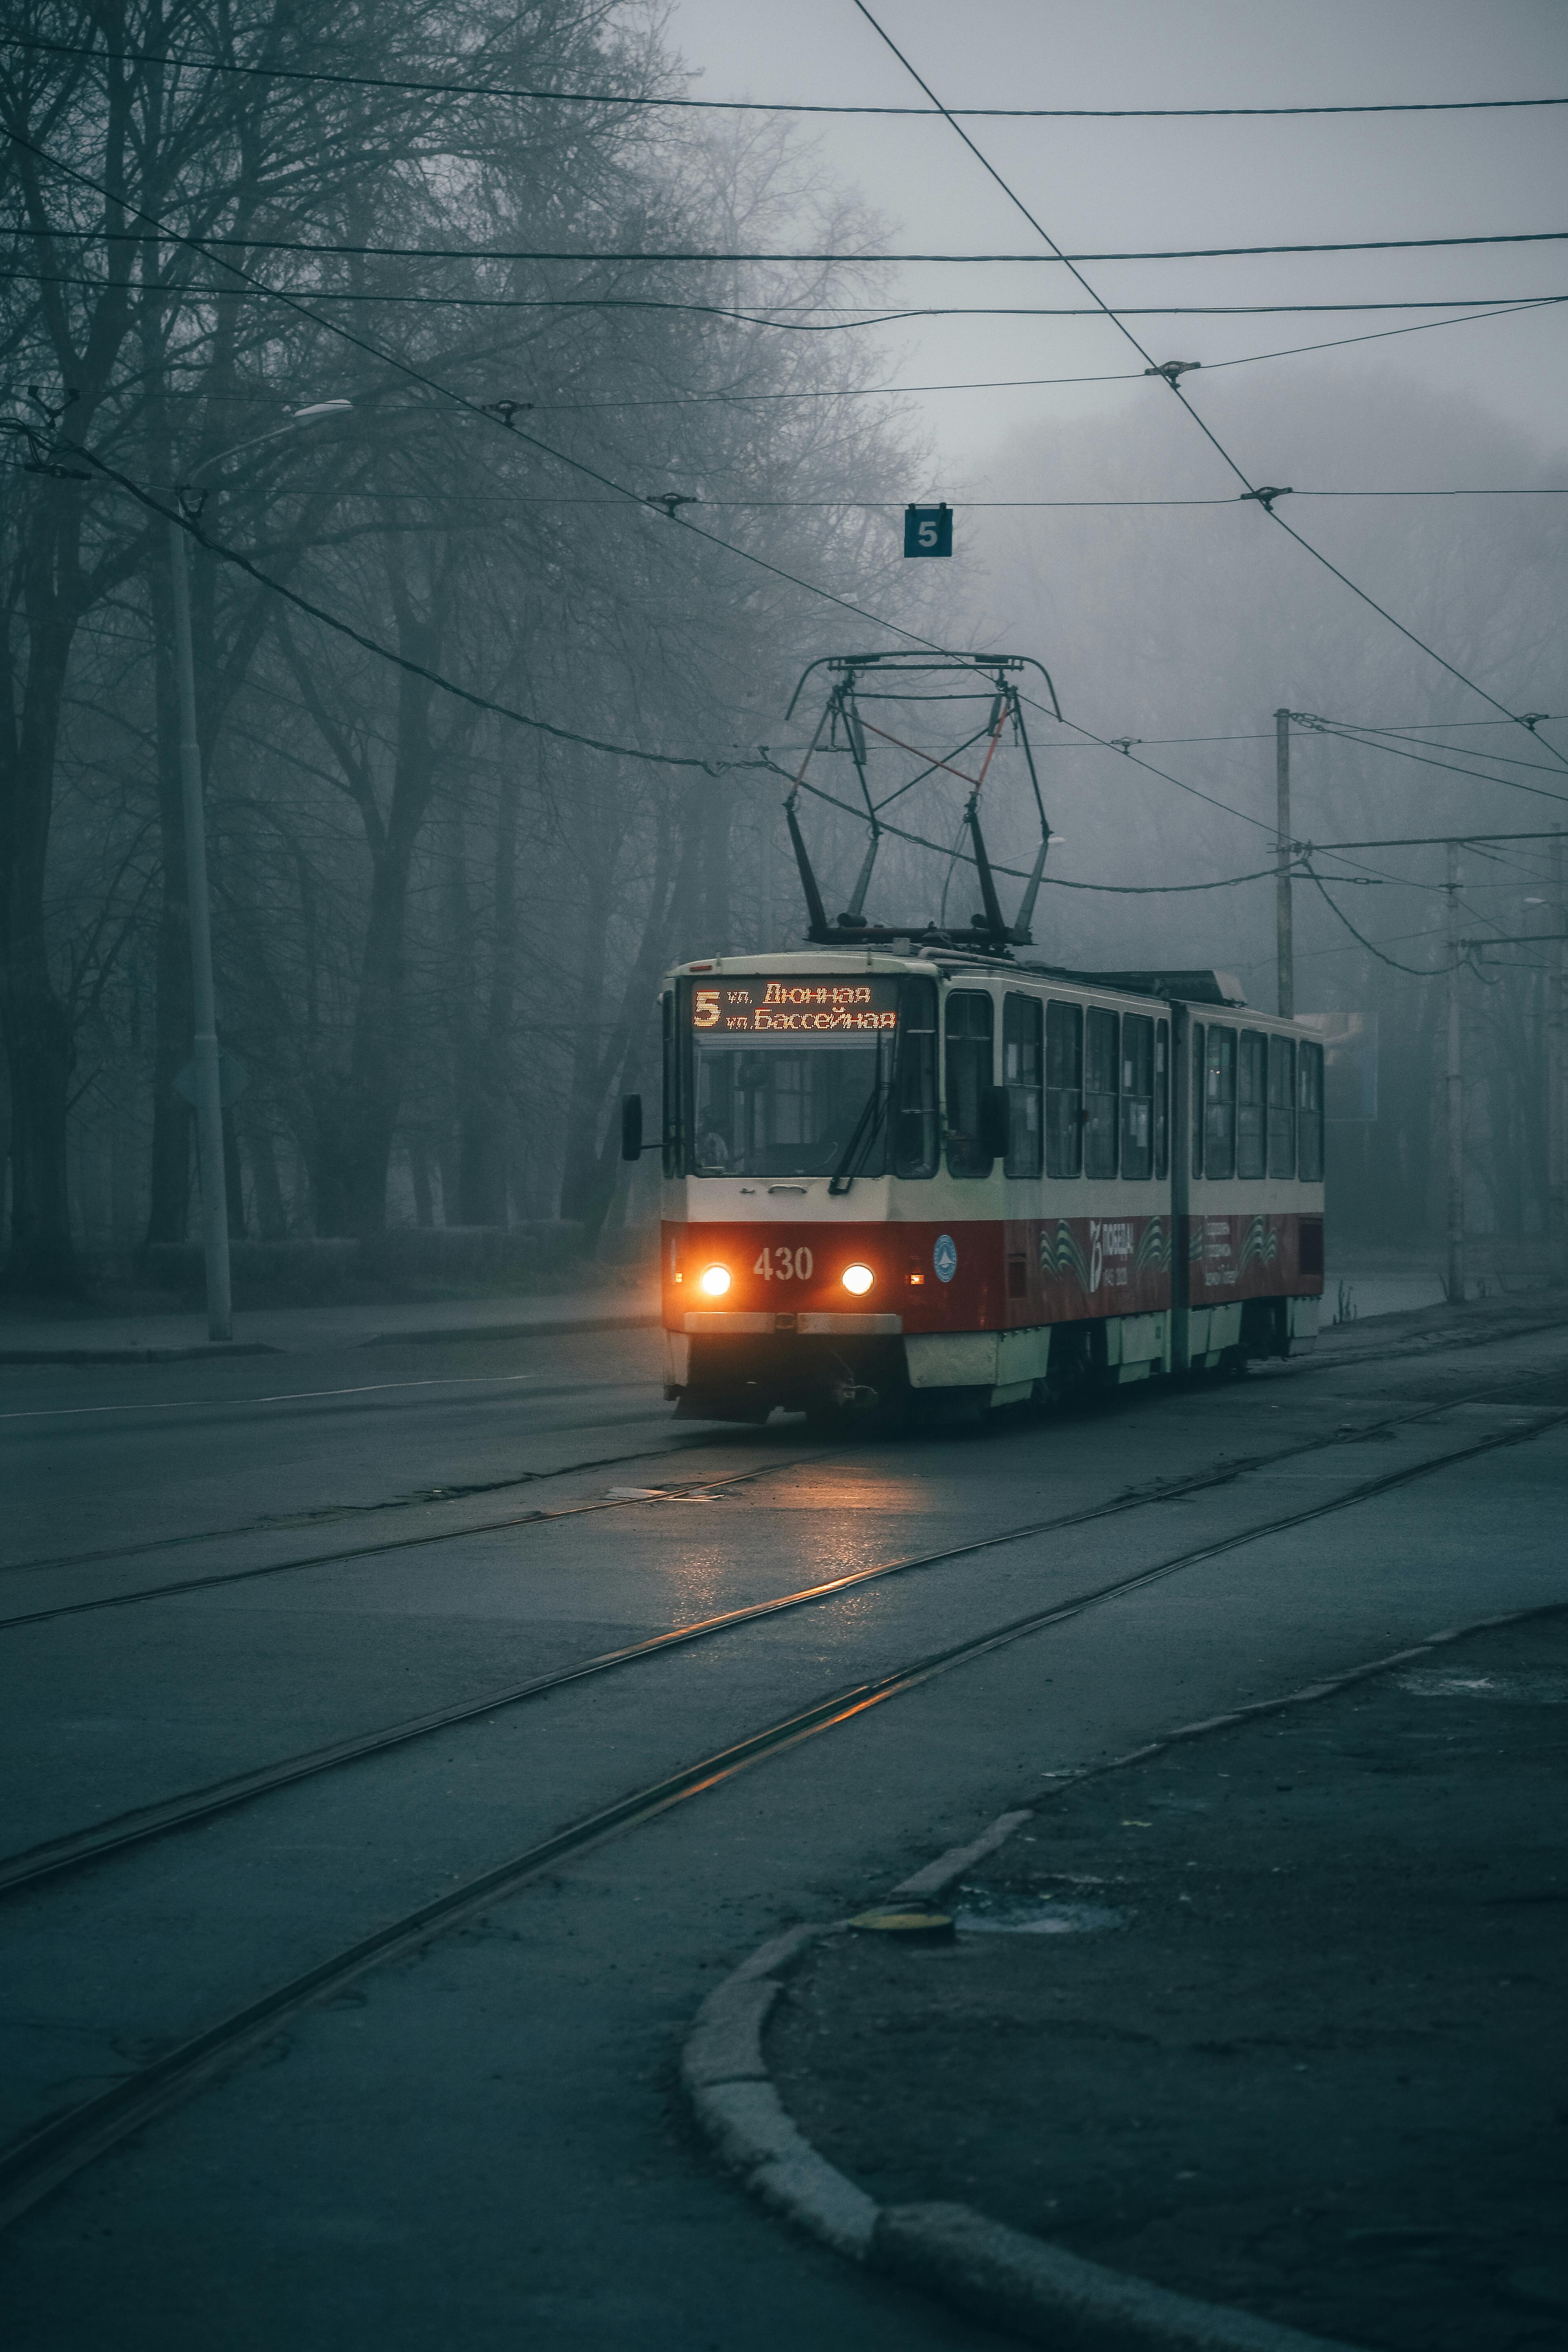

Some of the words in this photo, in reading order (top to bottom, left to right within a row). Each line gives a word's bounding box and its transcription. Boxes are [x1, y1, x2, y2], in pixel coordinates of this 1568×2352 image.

[918, 521, 938, 547] 5
[727, 991, 753, 1004] ул.
[762, 983, 871, 1004] Дюнная
[694, 991, 721, 1027] 5
[753, 1247, 813, 1281] 430
